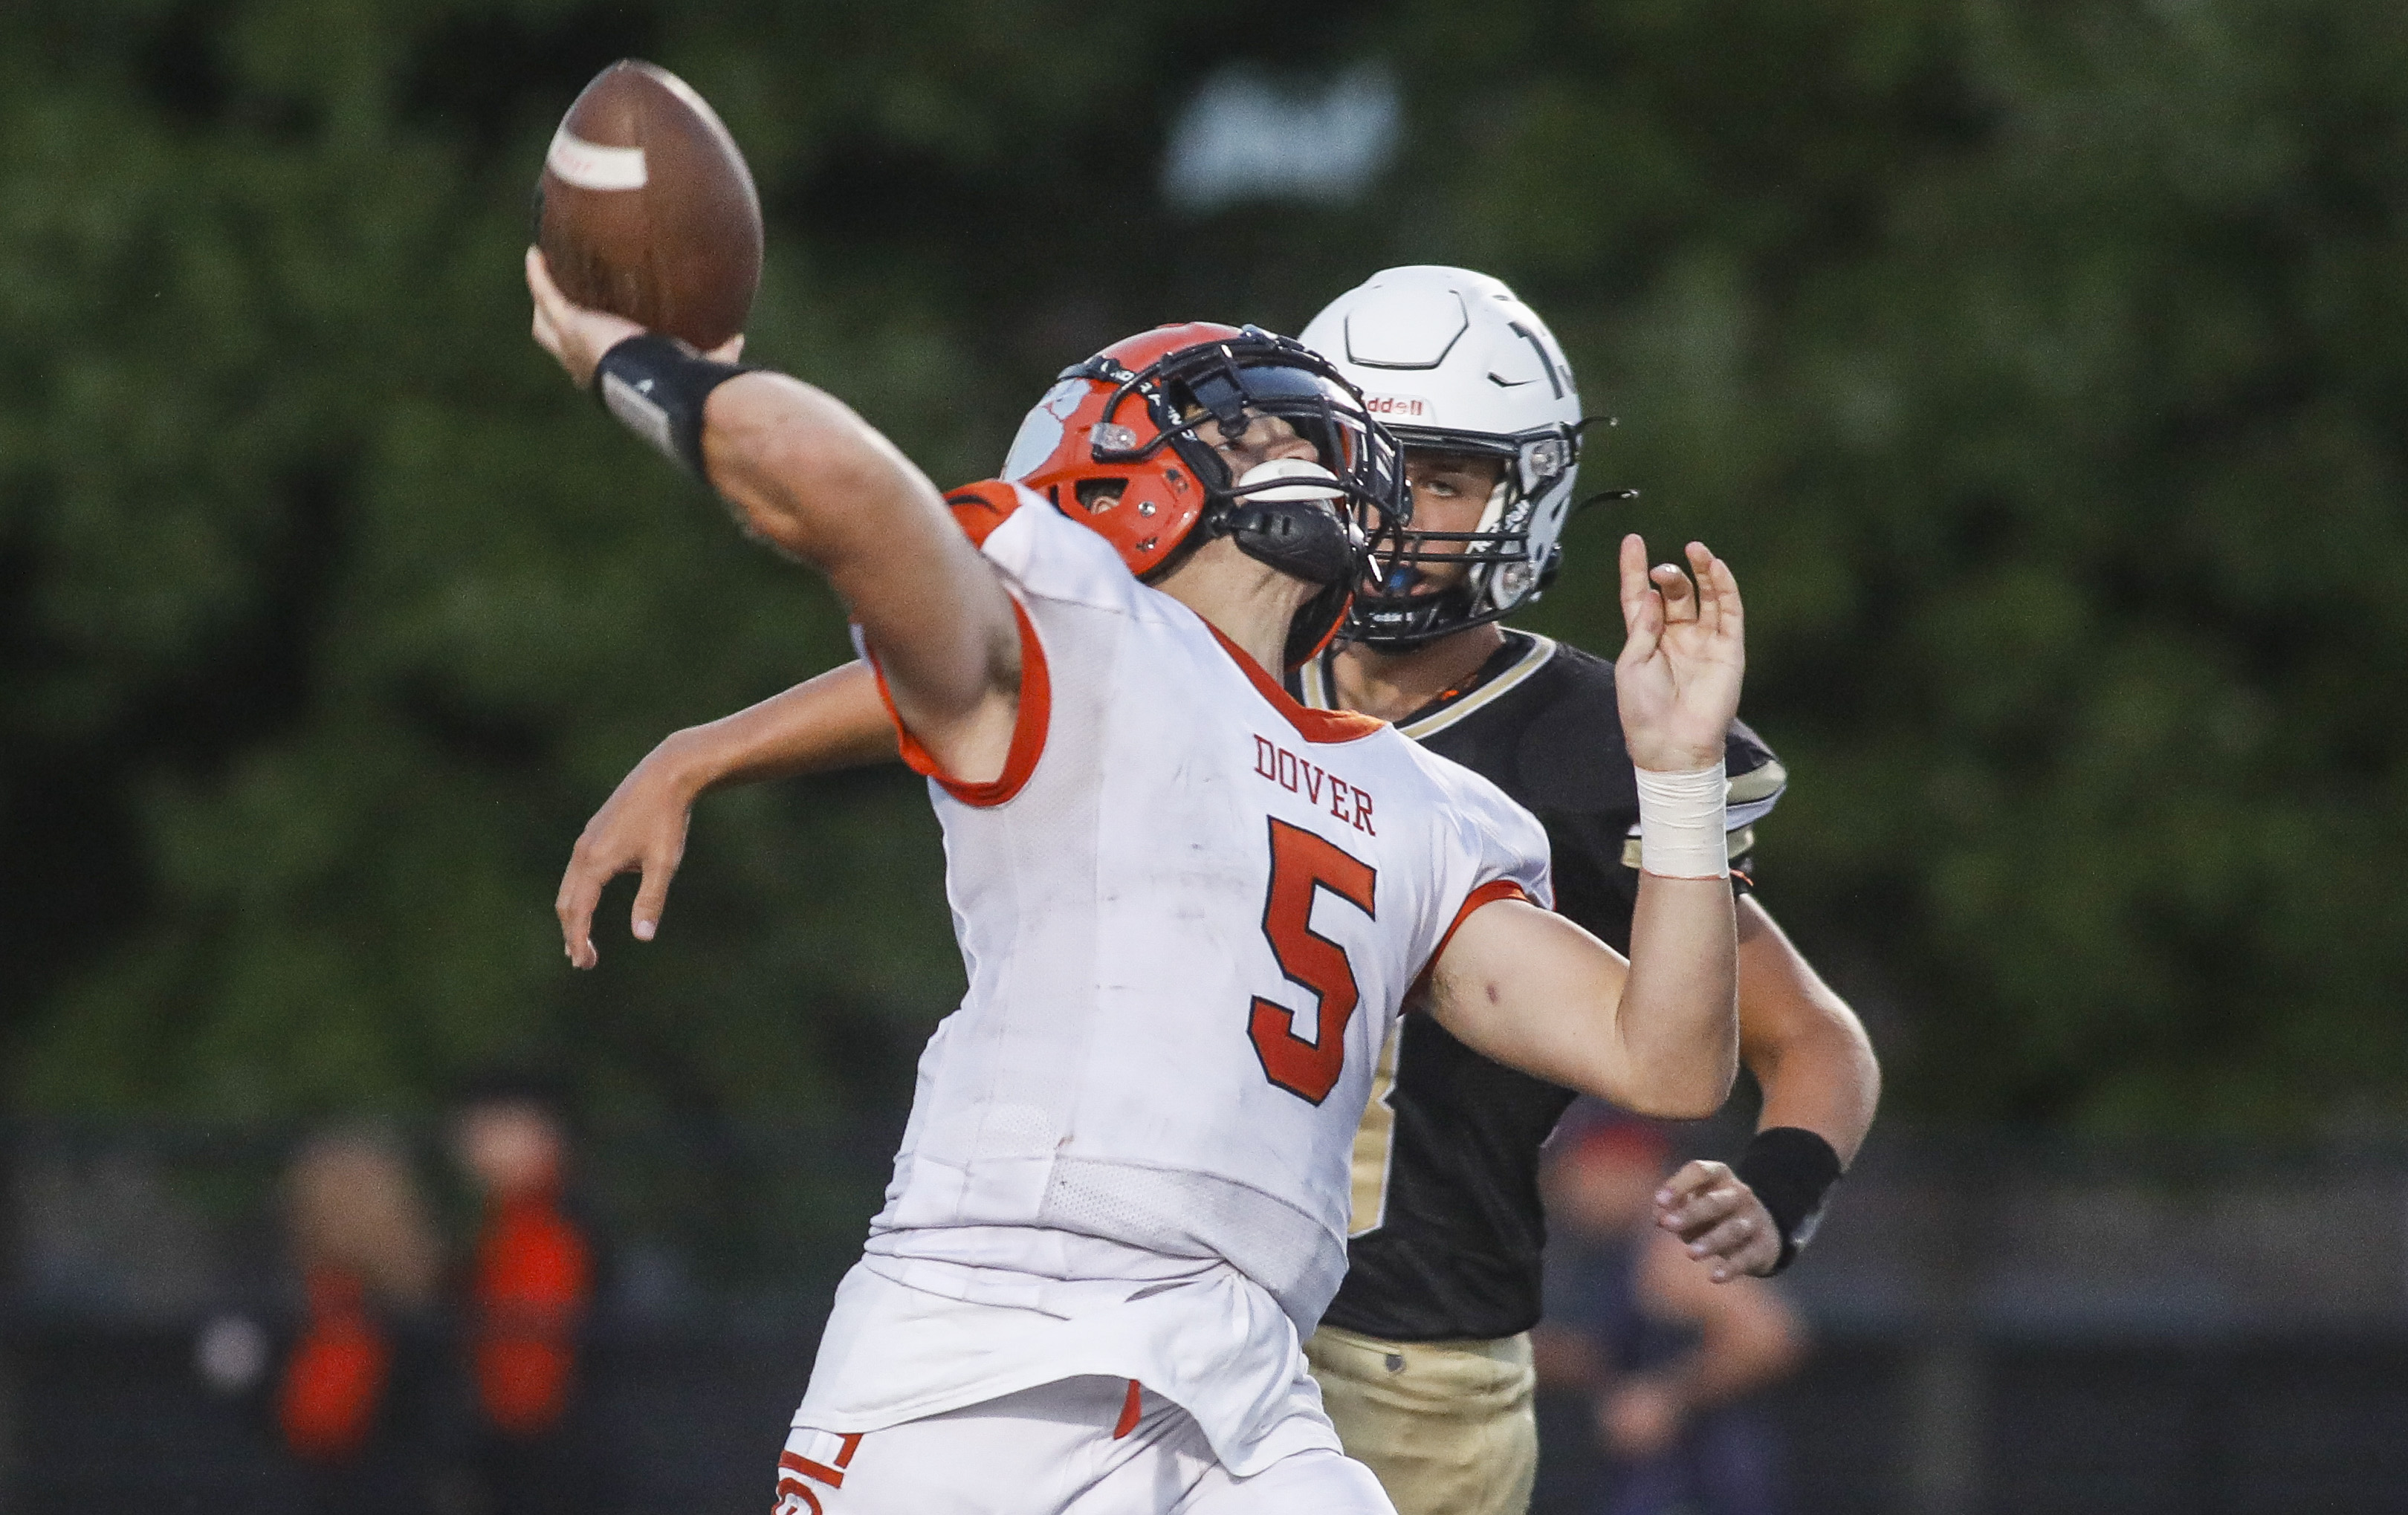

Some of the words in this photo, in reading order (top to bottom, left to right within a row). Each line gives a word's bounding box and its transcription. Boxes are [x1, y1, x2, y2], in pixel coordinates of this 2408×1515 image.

[1361, 398, 1423, 415] ddell
[1253, 733, 1376, 837] DOVER
[1246, 814, 1376, 1106] 5
